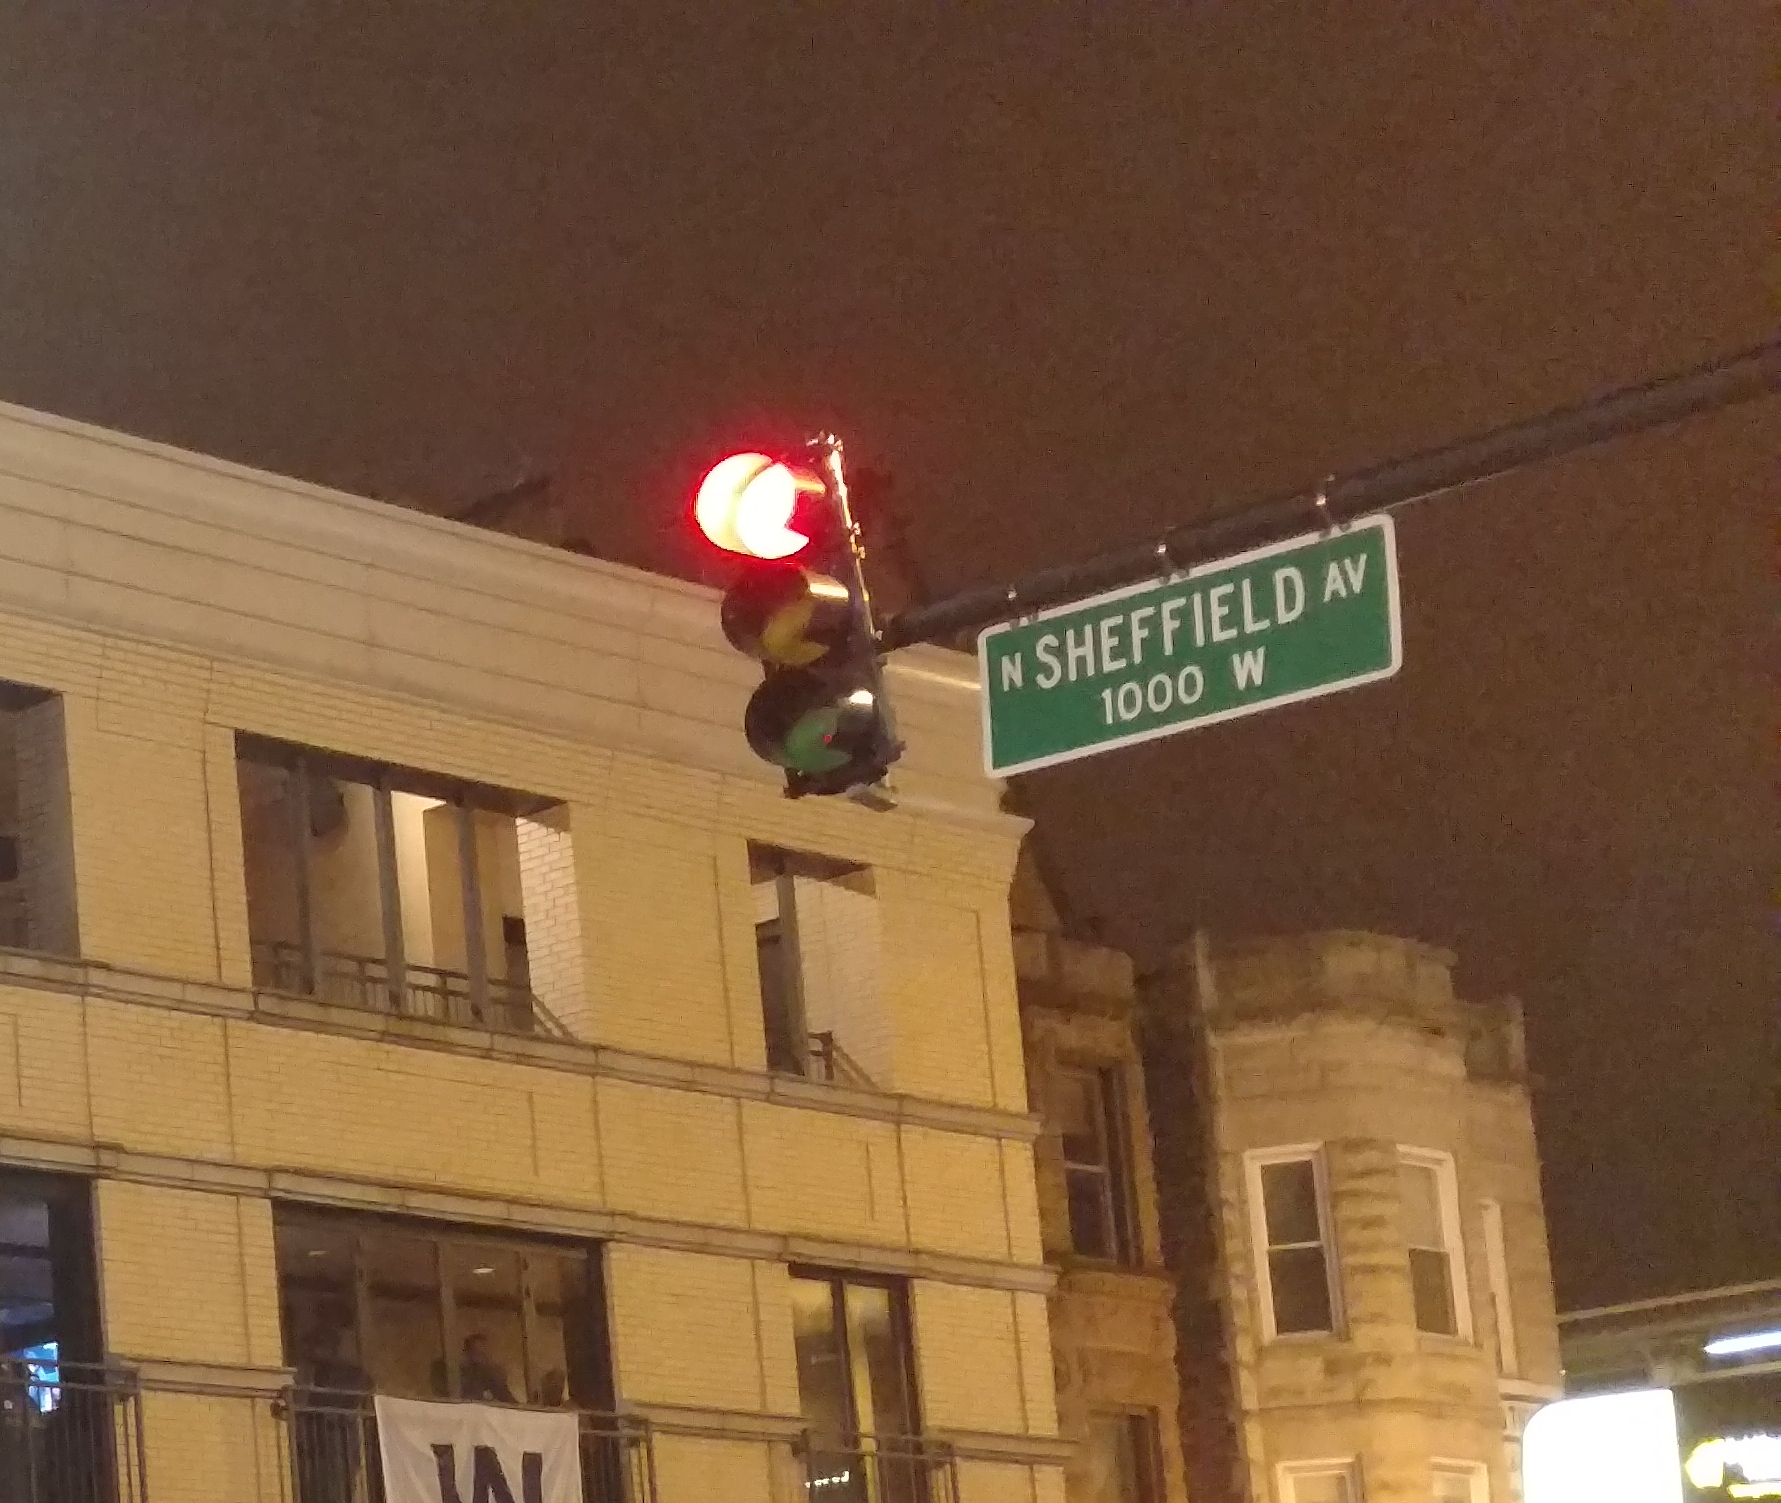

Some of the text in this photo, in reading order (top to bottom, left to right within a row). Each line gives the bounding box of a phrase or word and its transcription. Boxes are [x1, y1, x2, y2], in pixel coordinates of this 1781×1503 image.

[1001, 553, 1367, 692] N SHEFFIELD AV
[1101, 647, 1266, 724] 1000 W
